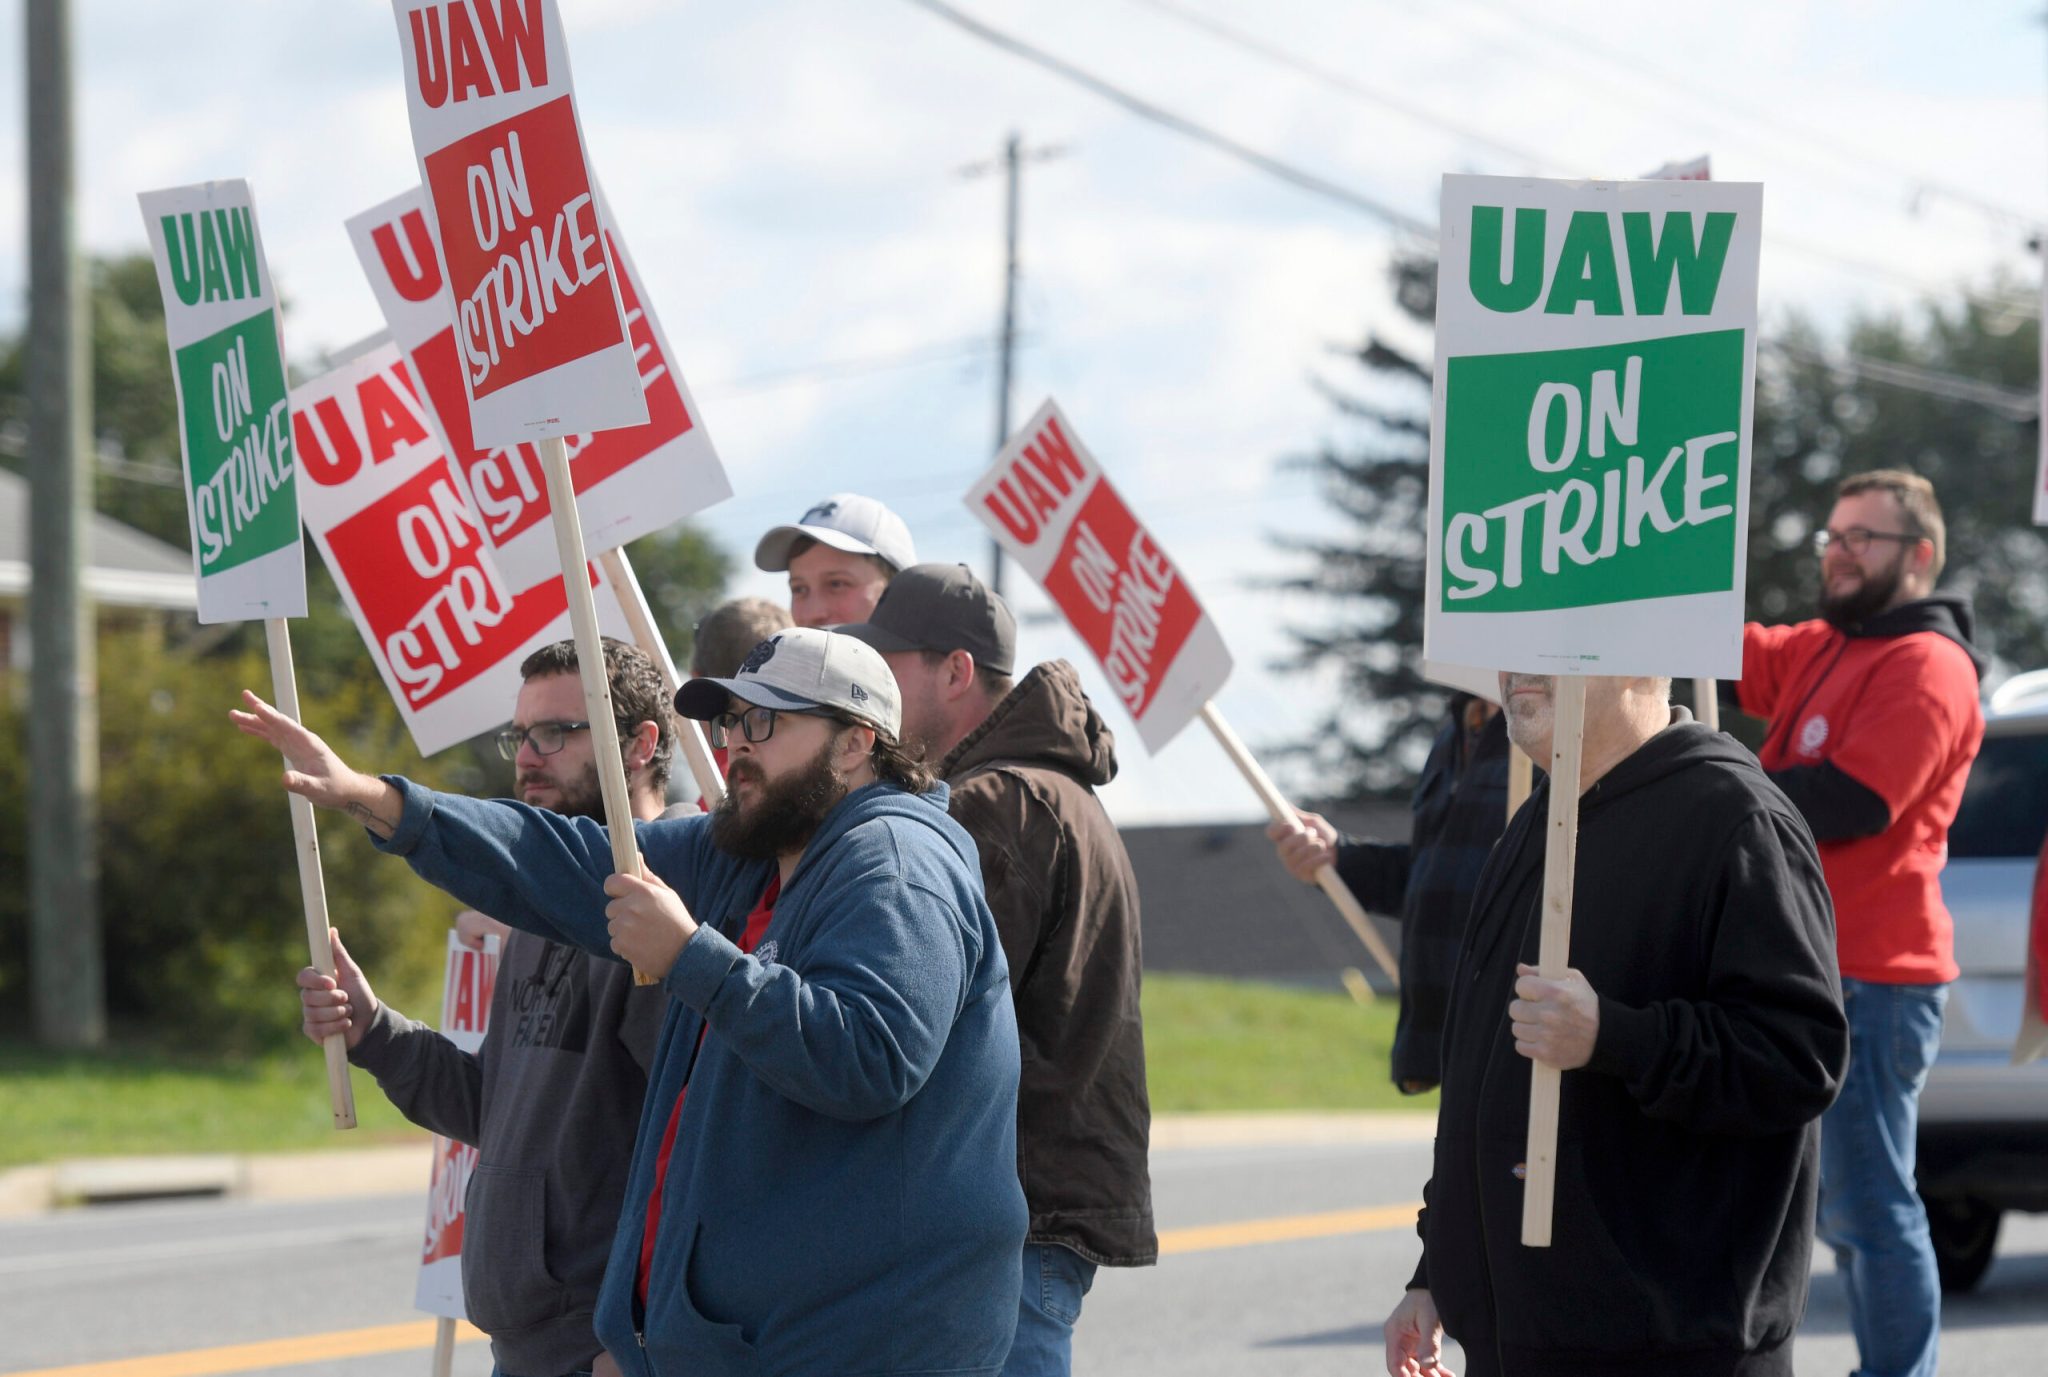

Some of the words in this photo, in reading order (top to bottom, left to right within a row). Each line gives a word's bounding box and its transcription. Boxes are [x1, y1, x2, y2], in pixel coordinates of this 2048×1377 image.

[408, 0, 548, 109] UAW
[467, 131, 533, 251] ON
[160, 206, 261, 306] UAW
[461, 192, 605, 387] STRIKE
[1469, 205, 1737, 315] UAW
[212, 335, 252, 442] ON
[293, 357, 430, 488] UA
[1527, 355, 1642, 473] ON
[196, 398, 293, 565] STRIKE
[983, 415, 1086, 546] UAW
[1445, 431, 1737, 600] STRIKE
[386, 544, 515, 702] STRI
[1070, 520, 1118, 614] ON
[1103, 528, 1174, 715] STRIKE
[512, 1014, 553, 1048] FAE
